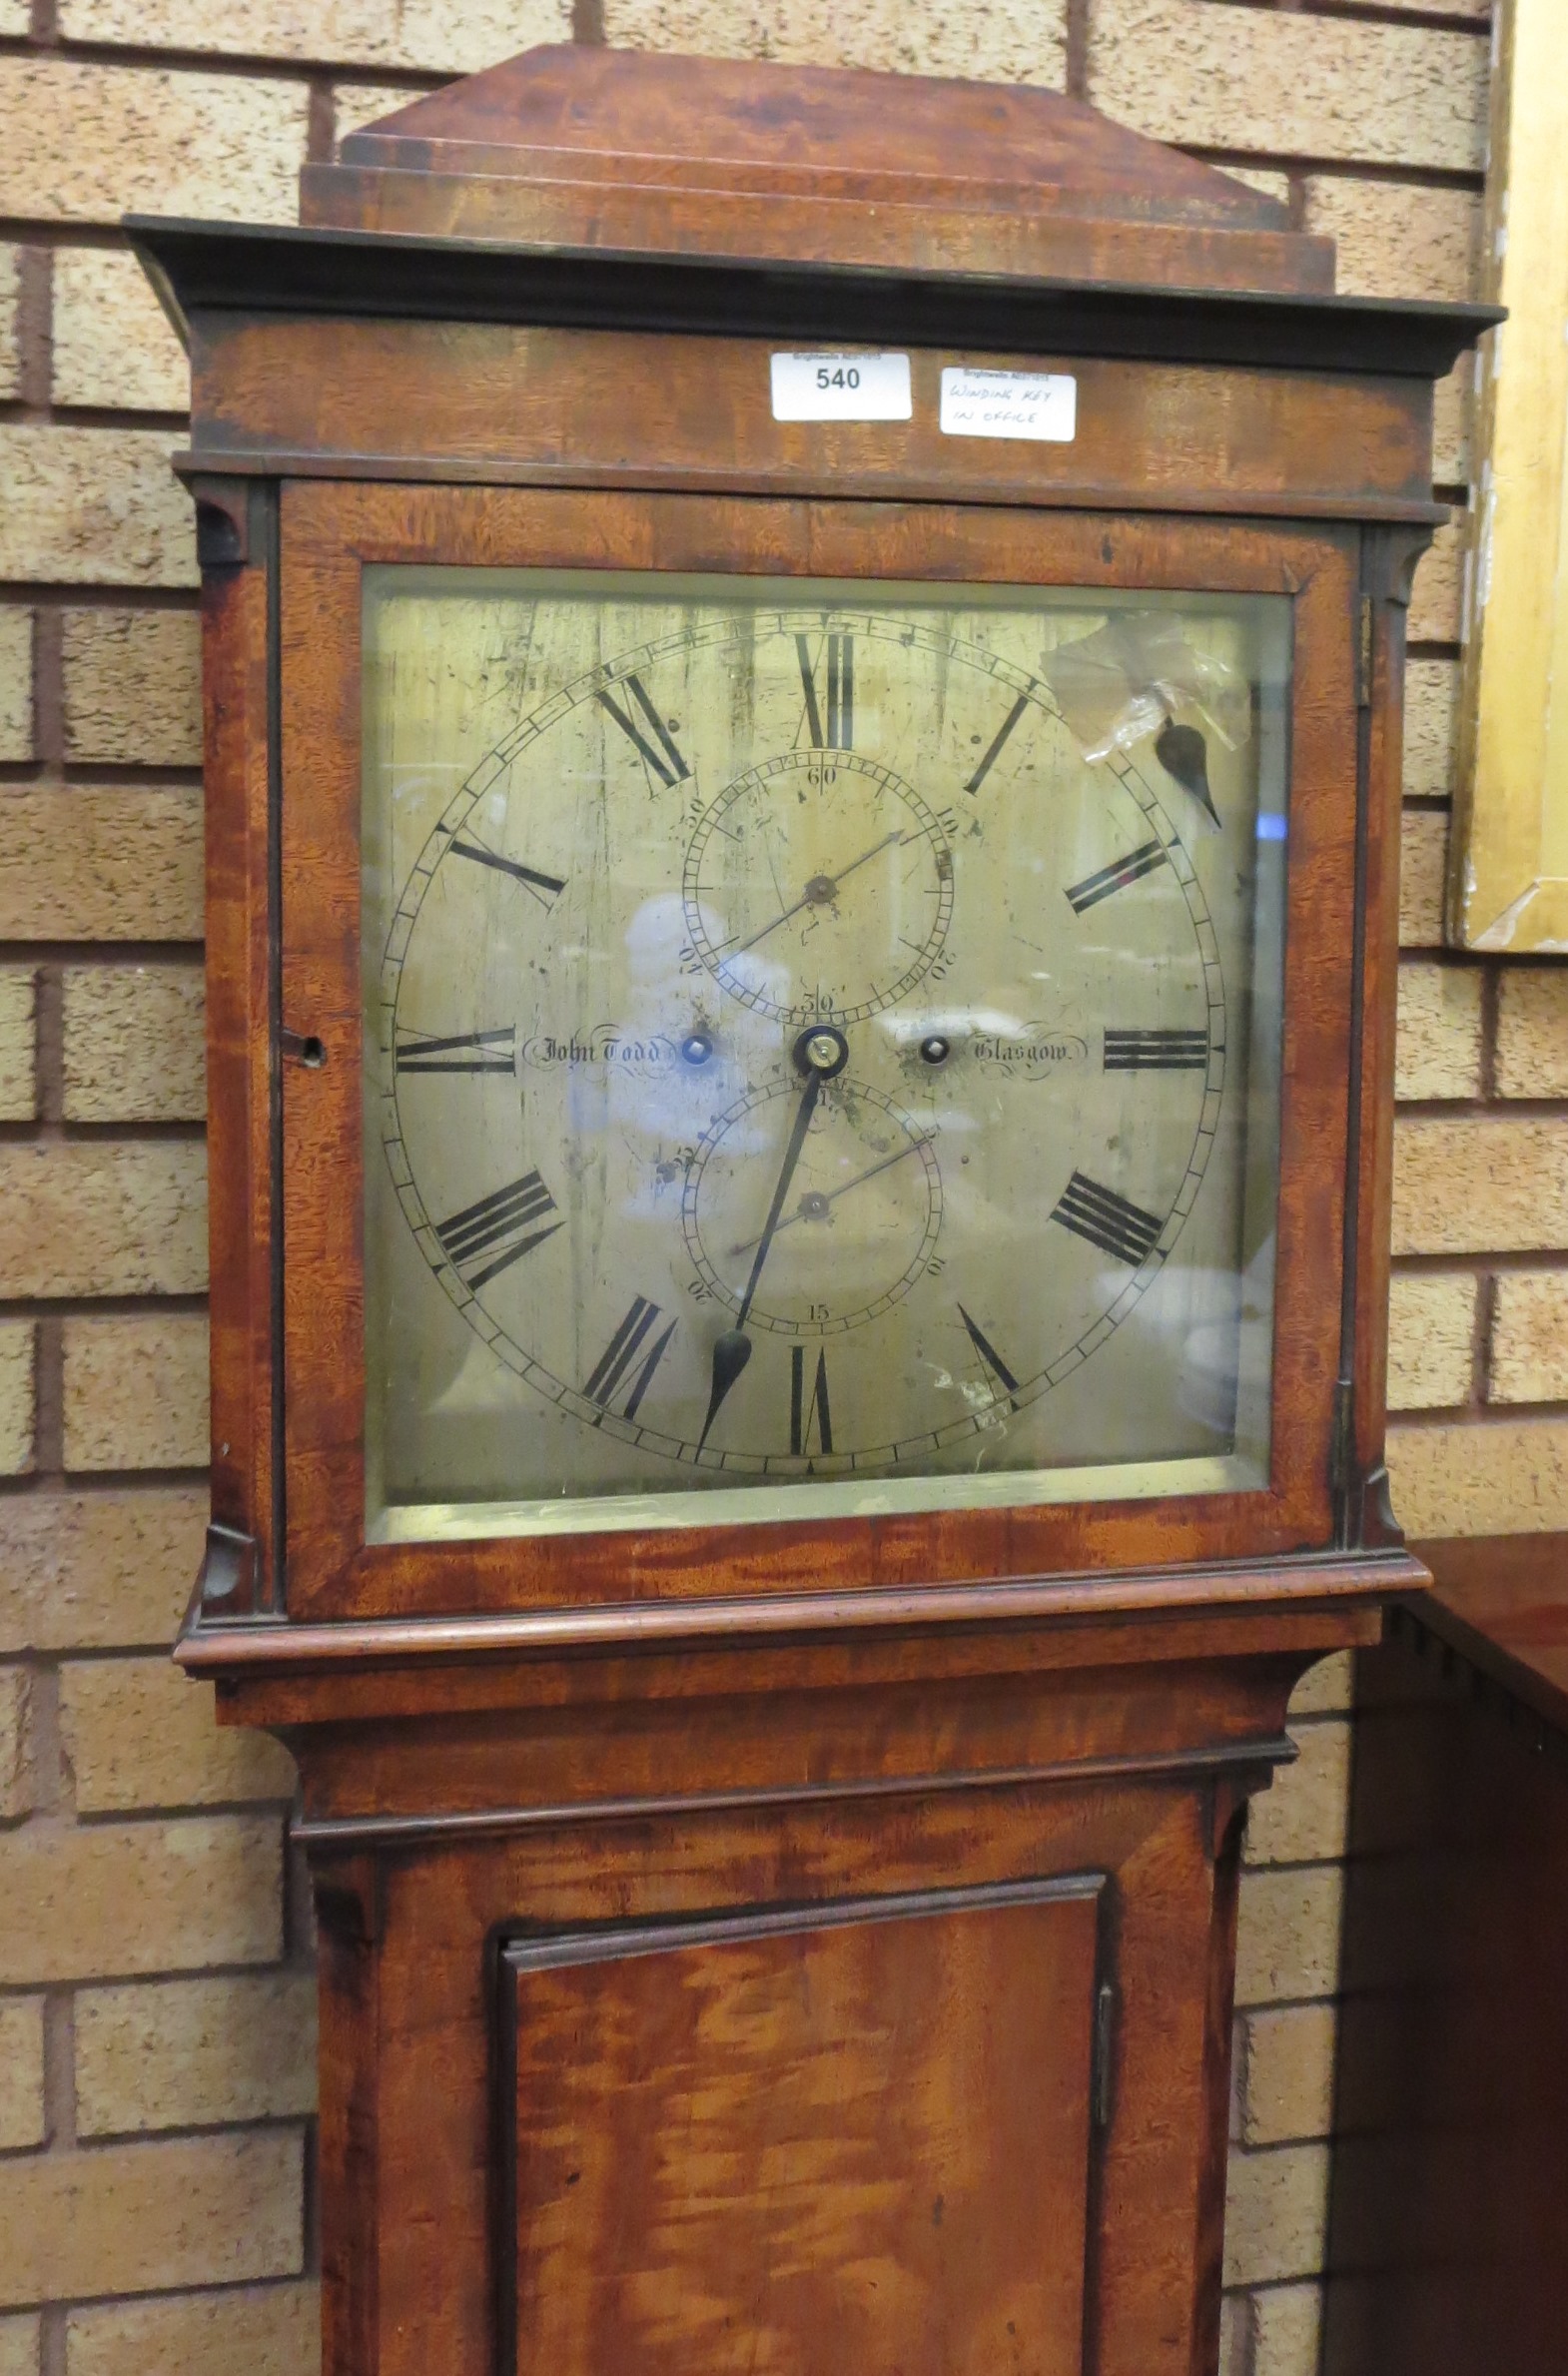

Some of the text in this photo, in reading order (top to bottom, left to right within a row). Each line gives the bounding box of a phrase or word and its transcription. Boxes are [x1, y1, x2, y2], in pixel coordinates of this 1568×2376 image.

[817, 368, 860, 390] 540
[950, 385, 1052, 401] WINDING KEY
[953, 410, 1038, 423] IN OFFICE
[792, 633, 856, 751] XII
[807, 767, 837, 786] 60
[540, 1036, 660, 1066] John Todd
[807, 1304, 830, 1320] 15
